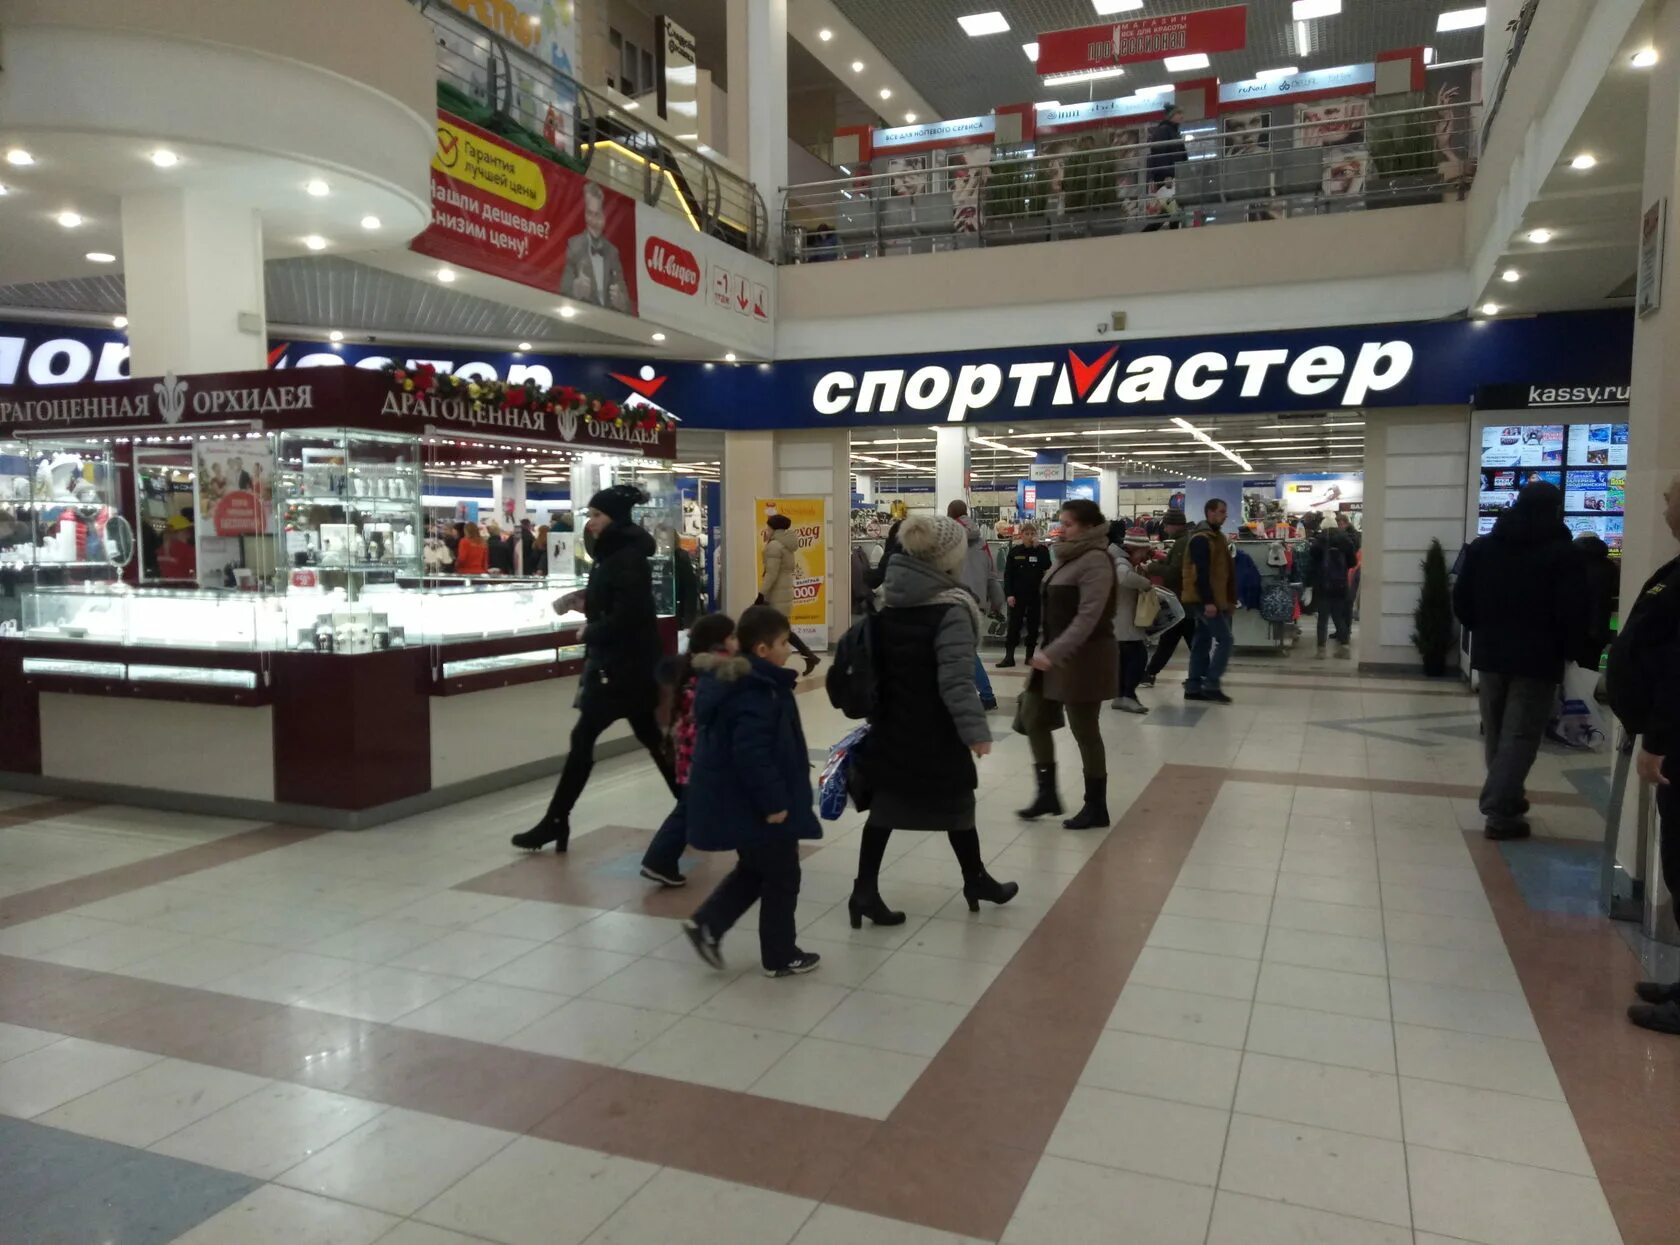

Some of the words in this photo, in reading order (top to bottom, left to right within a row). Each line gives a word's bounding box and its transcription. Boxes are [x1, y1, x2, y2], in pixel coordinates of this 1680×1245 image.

[1121, 15, 1187, 30] МАГАЗИН
[1137, 27, 1151, 36] ДЛЯ
[1153, 23, 1187, 33] КРАСОТЫ
[464, 140, 516, 175] Гарантия
[464, 161, 508, 188] лучшей
[509, 181, 538, 201] цены
[431, 203, 487, 241] низим
[489, 229, 529, 259] цену!
[482, 203, 551, 240] дешевле?
[193, 385, 313, 414] ОРХИДЕЯ
[1528, 385, 1632, 405] kassy.ru
[381, 390, 546, 431] ДРАГОЦЕННАЯ
[588, 418, 660, 445] ОРХИДЕЯ
[798, 537, 814, 549] 017
